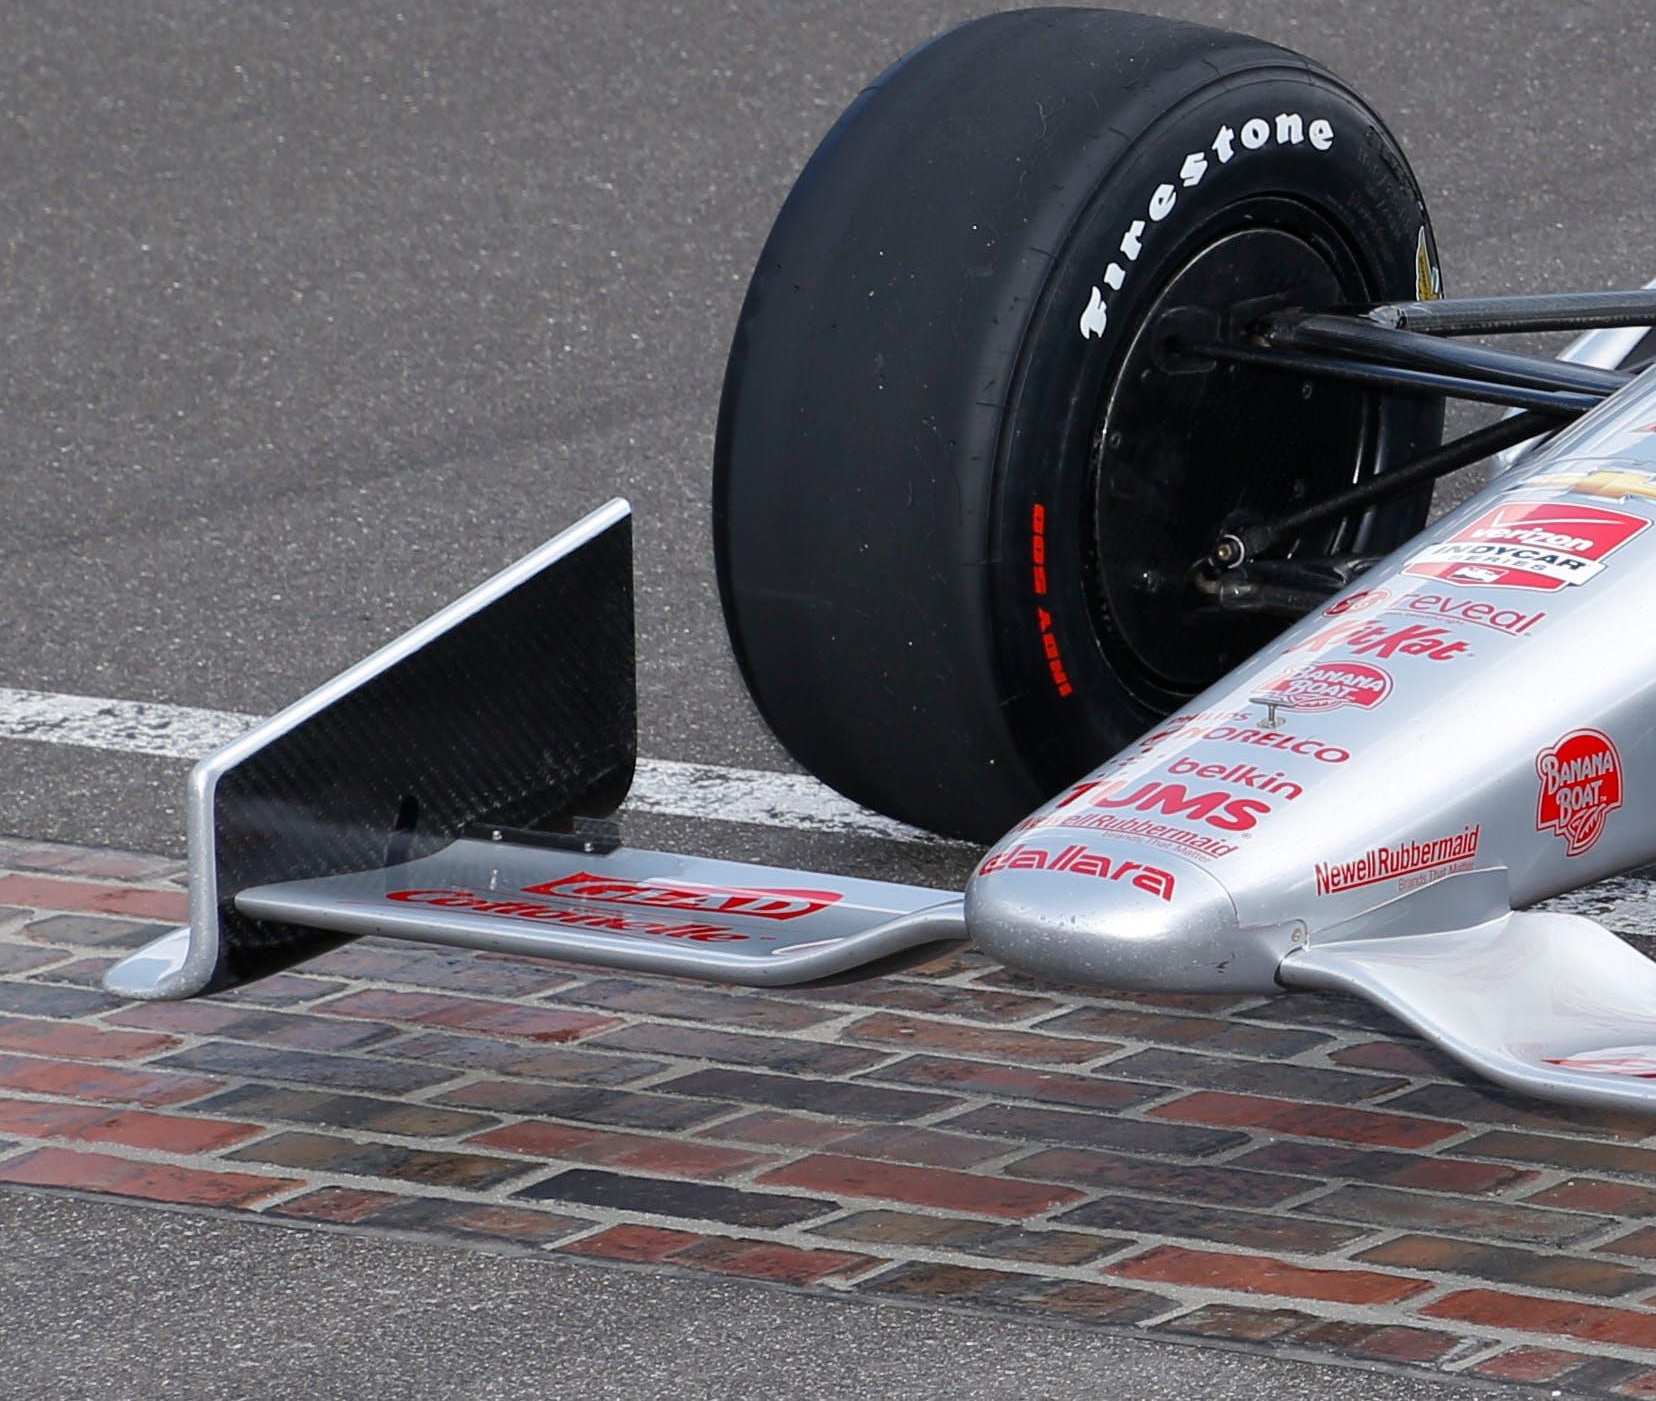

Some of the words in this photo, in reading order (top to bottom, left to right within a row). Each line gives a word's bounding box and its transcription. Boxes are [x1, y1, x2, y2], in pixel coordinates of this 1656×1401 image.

[1080, 113, 1335, 340] Firestone
[1437, 544, 1590, 572] INDYCAR
[1470, 525, 1594, 552] verizon
[1451, 554, 1549, 572] SERIES
[1389, 593, 1547, 636] reveal
[1282, 619, 1470, 661] KitKat
[1292, 664, 1384, 692] BANANA
[1178, 726, 1352, 765] NORELCO
[1167, 756, 1305, 802] belkin
[1543, 749, 1615, 795] BANANA
[1055, 780, 1272, 832] TUMS
[1555, 778, 1606, 826] BOAT
[978, 843, 1177, 902] dallara
